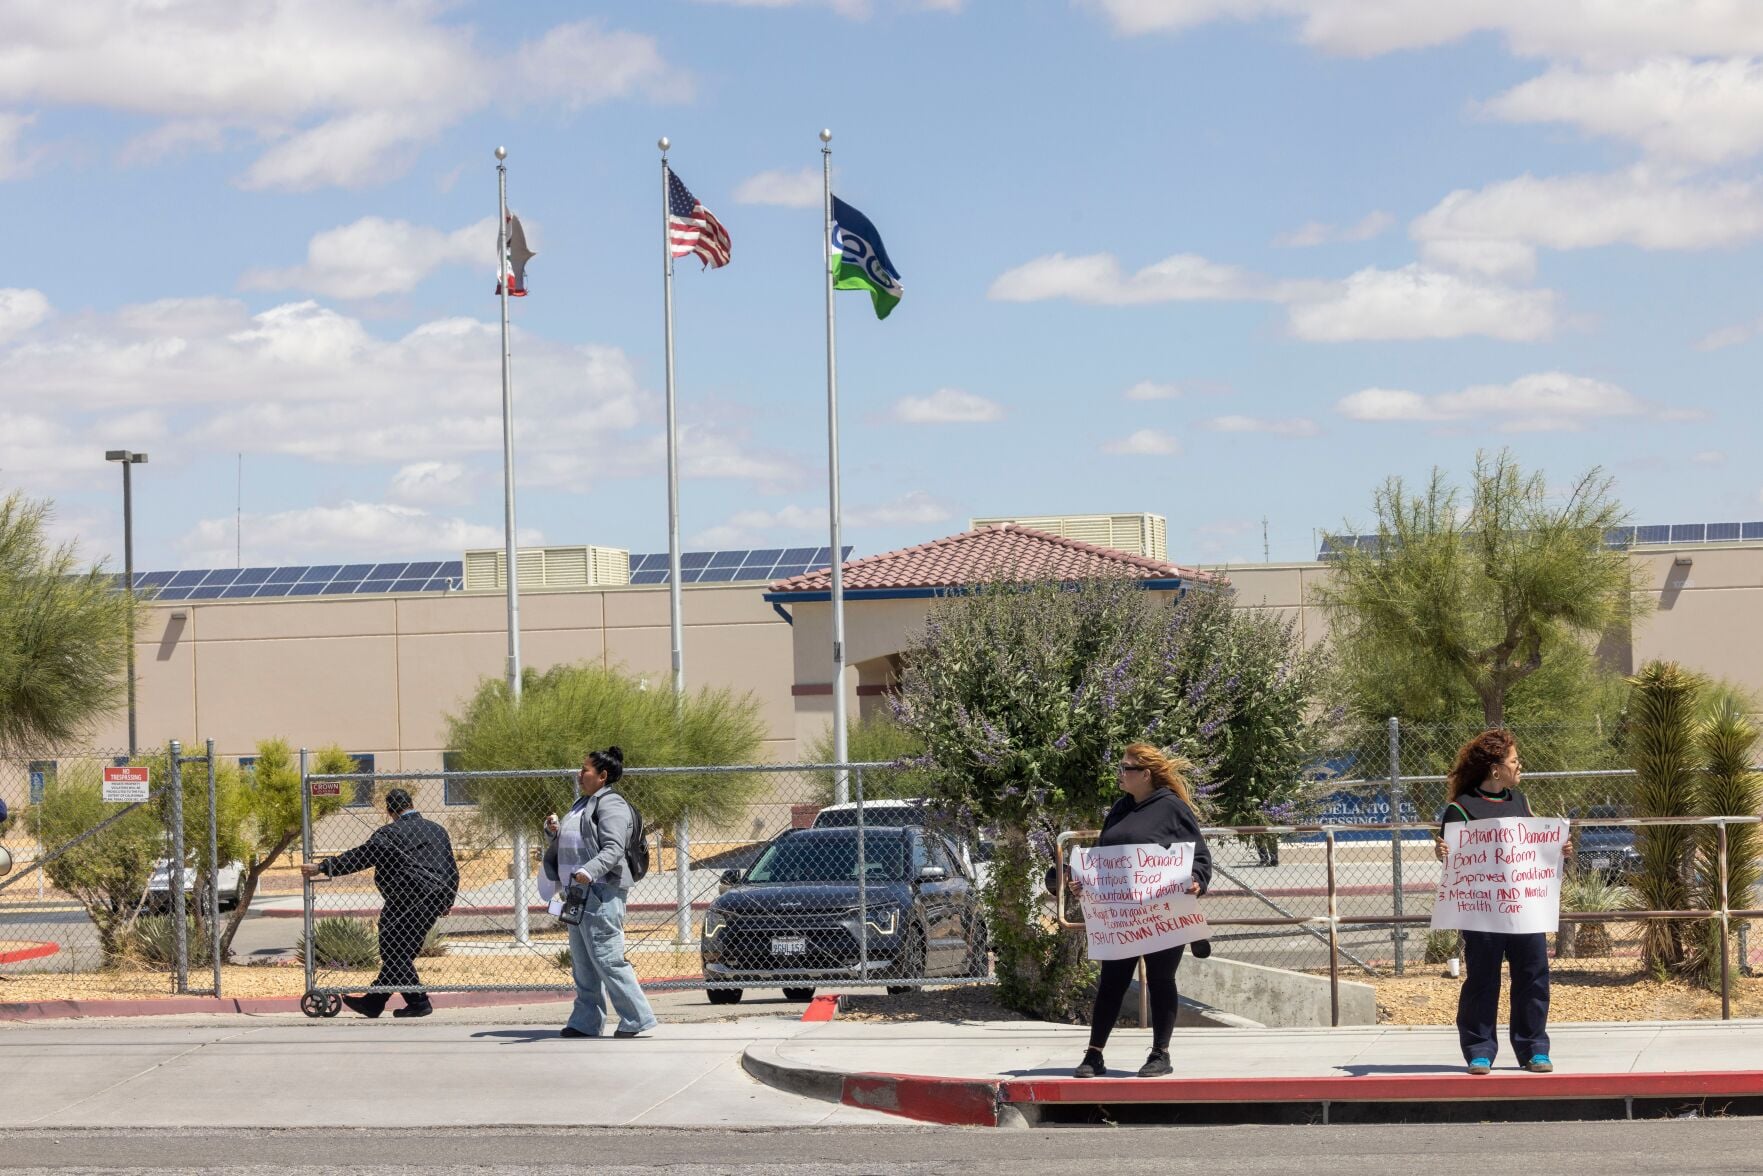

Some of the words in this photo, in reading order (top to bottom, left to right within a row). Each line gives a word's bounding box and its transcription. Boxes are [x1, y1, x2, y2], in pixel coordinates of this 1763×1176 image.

[1321, 802, 1390, 815] DELANTO
[1459, 827, 1515, 848] Detainees
[1518, 822, 1560, 845] Demand
[1080, 852, 1133, 870] Detainees
[1136, 846, 1184, 868] Demand
[1453, 850, 1487, 870] Bond
[1495, 846, 1536, 864] Reform
[1082, 872, 1128, 887] Nutritious
[1133, 870, 1162, 884] Food
[1452, 871, 1507, 886] Improved
[1511, 867, 1555, 883] Conditions
[1085, 887, 1143, 905] Accountability
[1155, 880, 1185, 898] deaths
[1449, 889, 1492, 901] Medical
[1496, 887, 1520, 901] AND
[1525, 885, 1548, 898] Mental
[1109, 907, 1118, 918] to
[1119, 903, 1160, 921] organize
[1458, 901, 1492, 912] Health
[1498, 902, 1523, 914] Care
[1107, 914, 1163, 929] communicate
[1117, 926, 1153, 945] DOWN
[1155, 913, 1204, 937] ADELANTO
